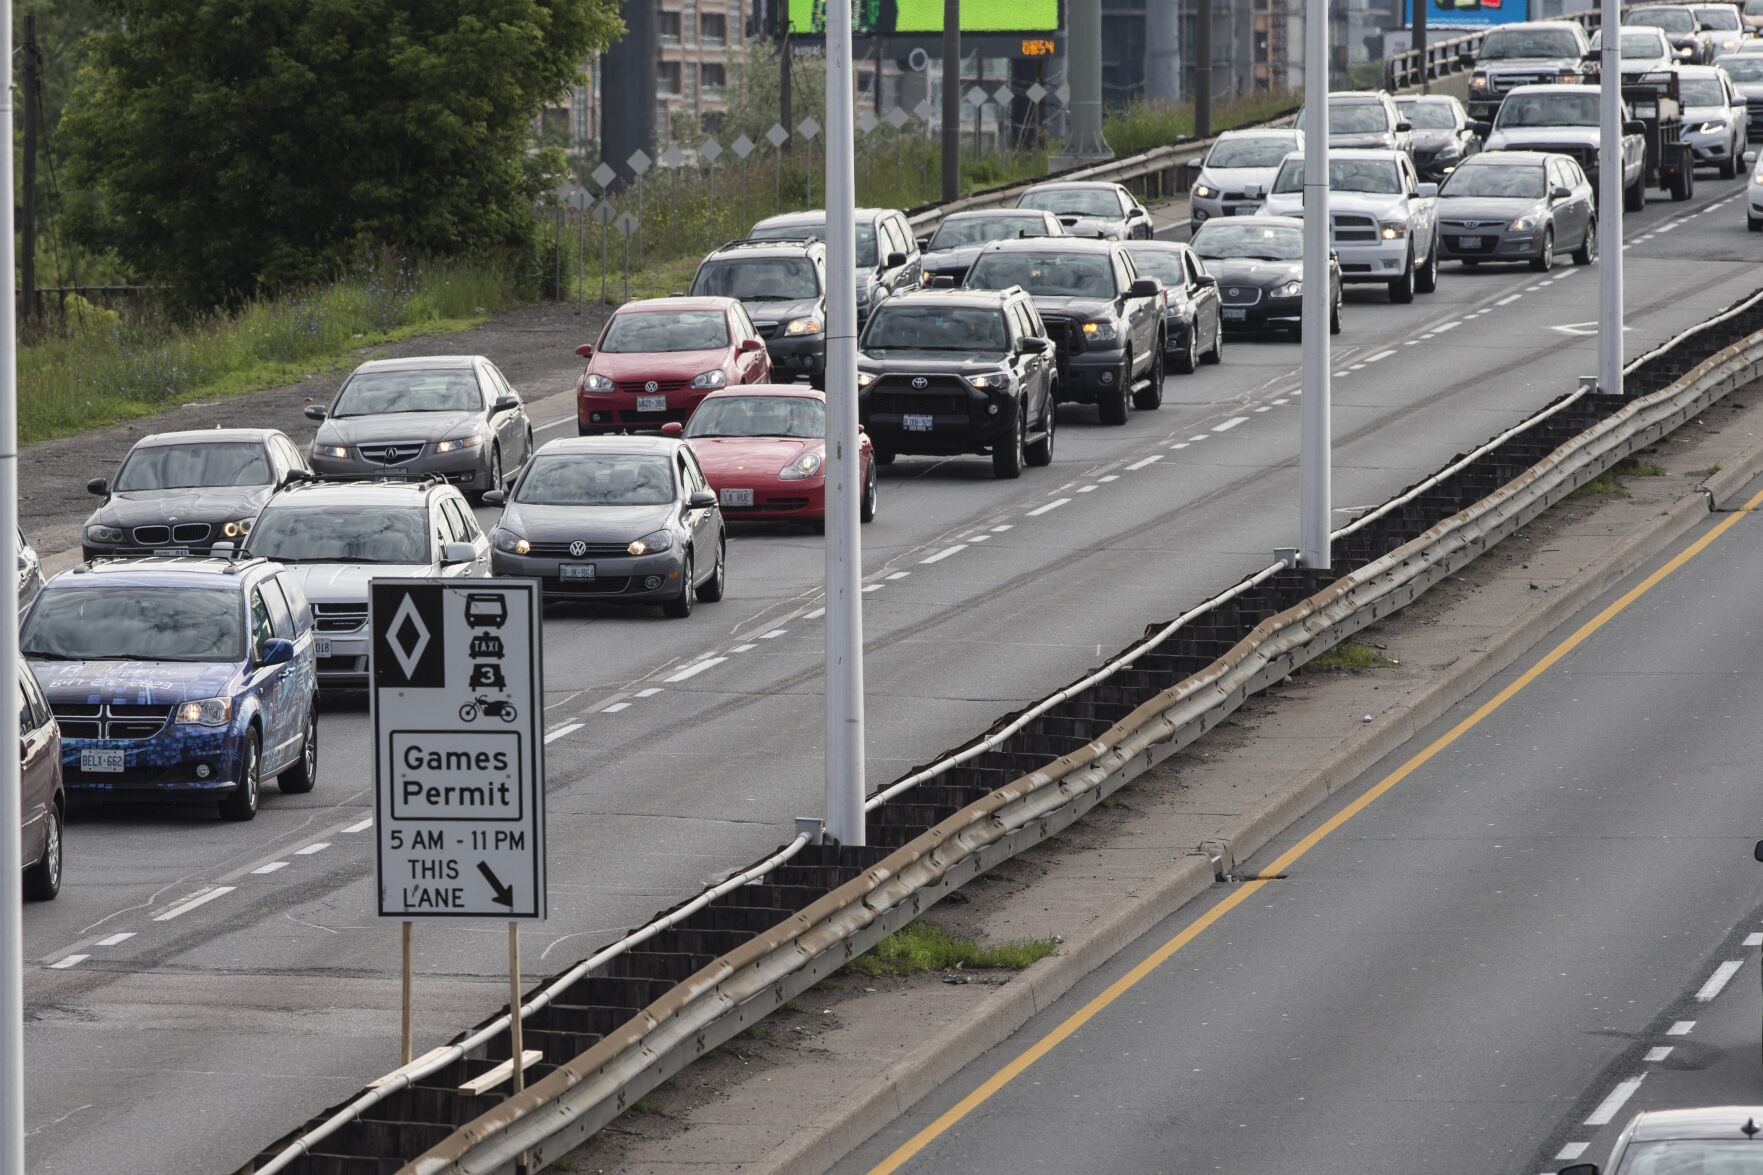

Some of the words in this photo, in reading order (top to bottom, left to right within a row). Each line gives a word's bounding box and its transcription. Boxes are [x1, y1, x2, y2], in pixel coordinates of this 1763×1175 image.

[474, 640, 499, 652] TAXI
[480, 667, 495, 683] 3
[404, 746, 508, 770] Games
[402, 781, 510, 806] Permit
[390, 830, 403, 850] 5
[410, 830, 444, 850] AM
[471, 830, 488, 850] 11
[495, 831, 525, 850] PM
[407, 859, 459, 880] THIS
[403, 888, 465, 907] LANE
